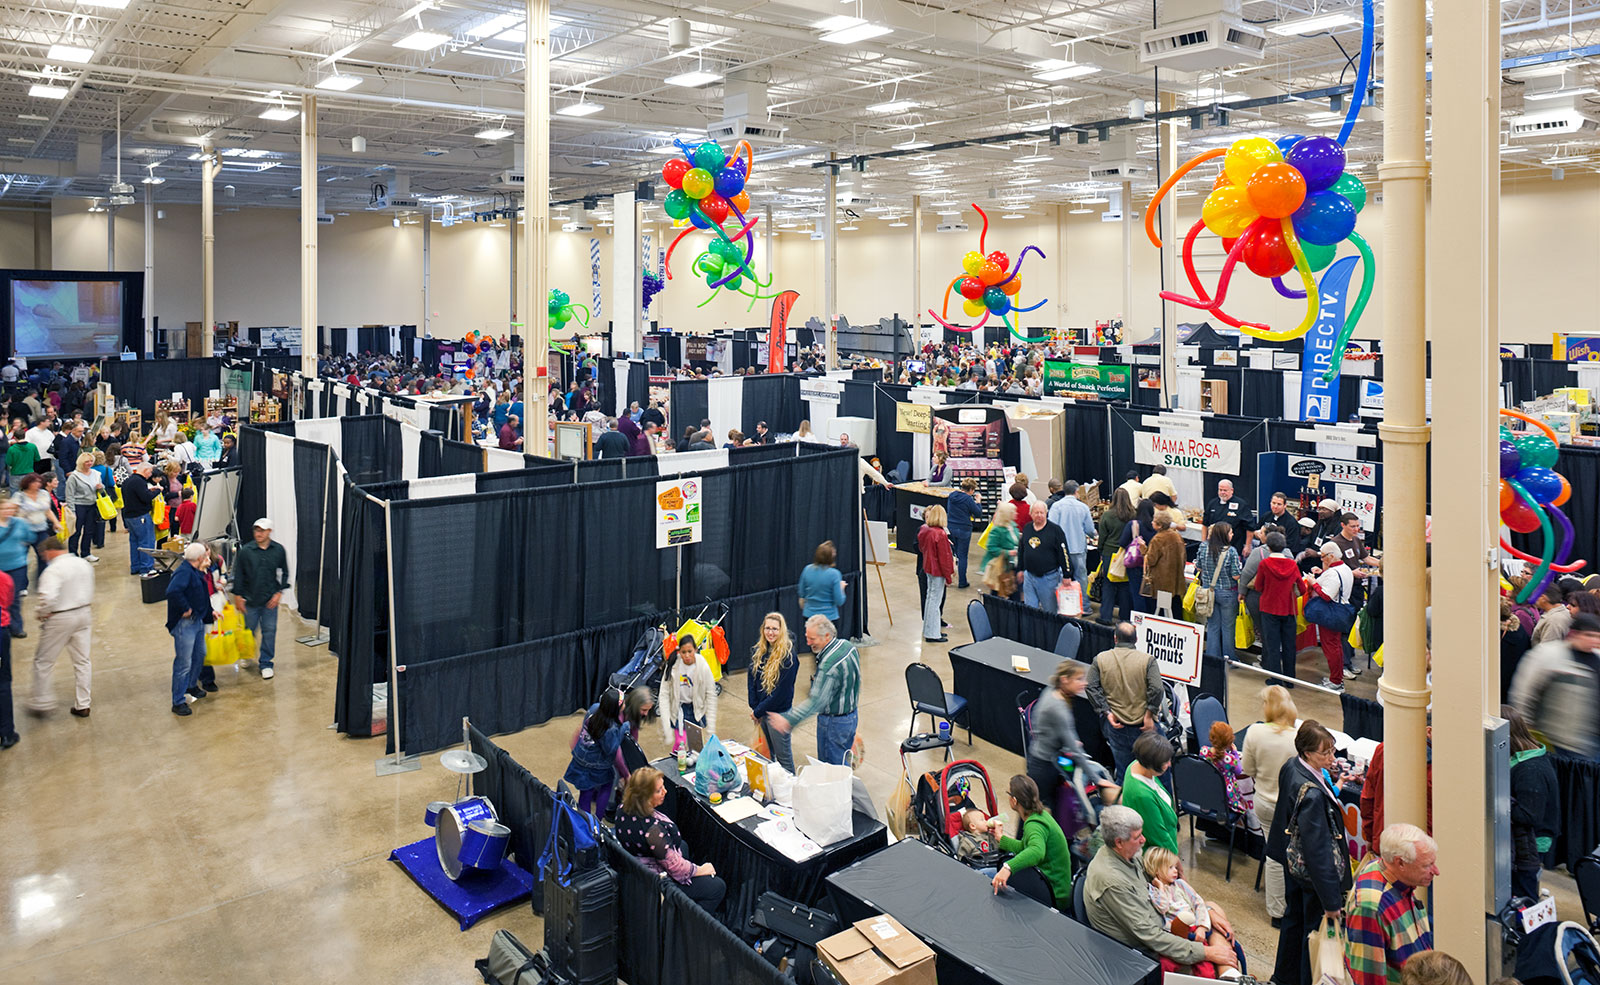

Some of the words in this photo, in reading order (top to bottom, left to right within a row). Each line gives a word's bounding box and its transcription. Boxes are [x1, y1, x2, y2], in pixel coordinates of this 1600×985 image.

[1568, 343, 1590, 361] Wish
[1078, 383, 1095, 391] Snack
[1152, 435, 1185, 455] MAMA
[1188, 439, 1220, 459] ROSA
[1164, 454, 1207, 469] SAUCE
[1331, 463, 1372, 479] BBQ
[1342, 499, 1374, 513] BBQ
[1146, 628, 1187, 650] Dunkin'
